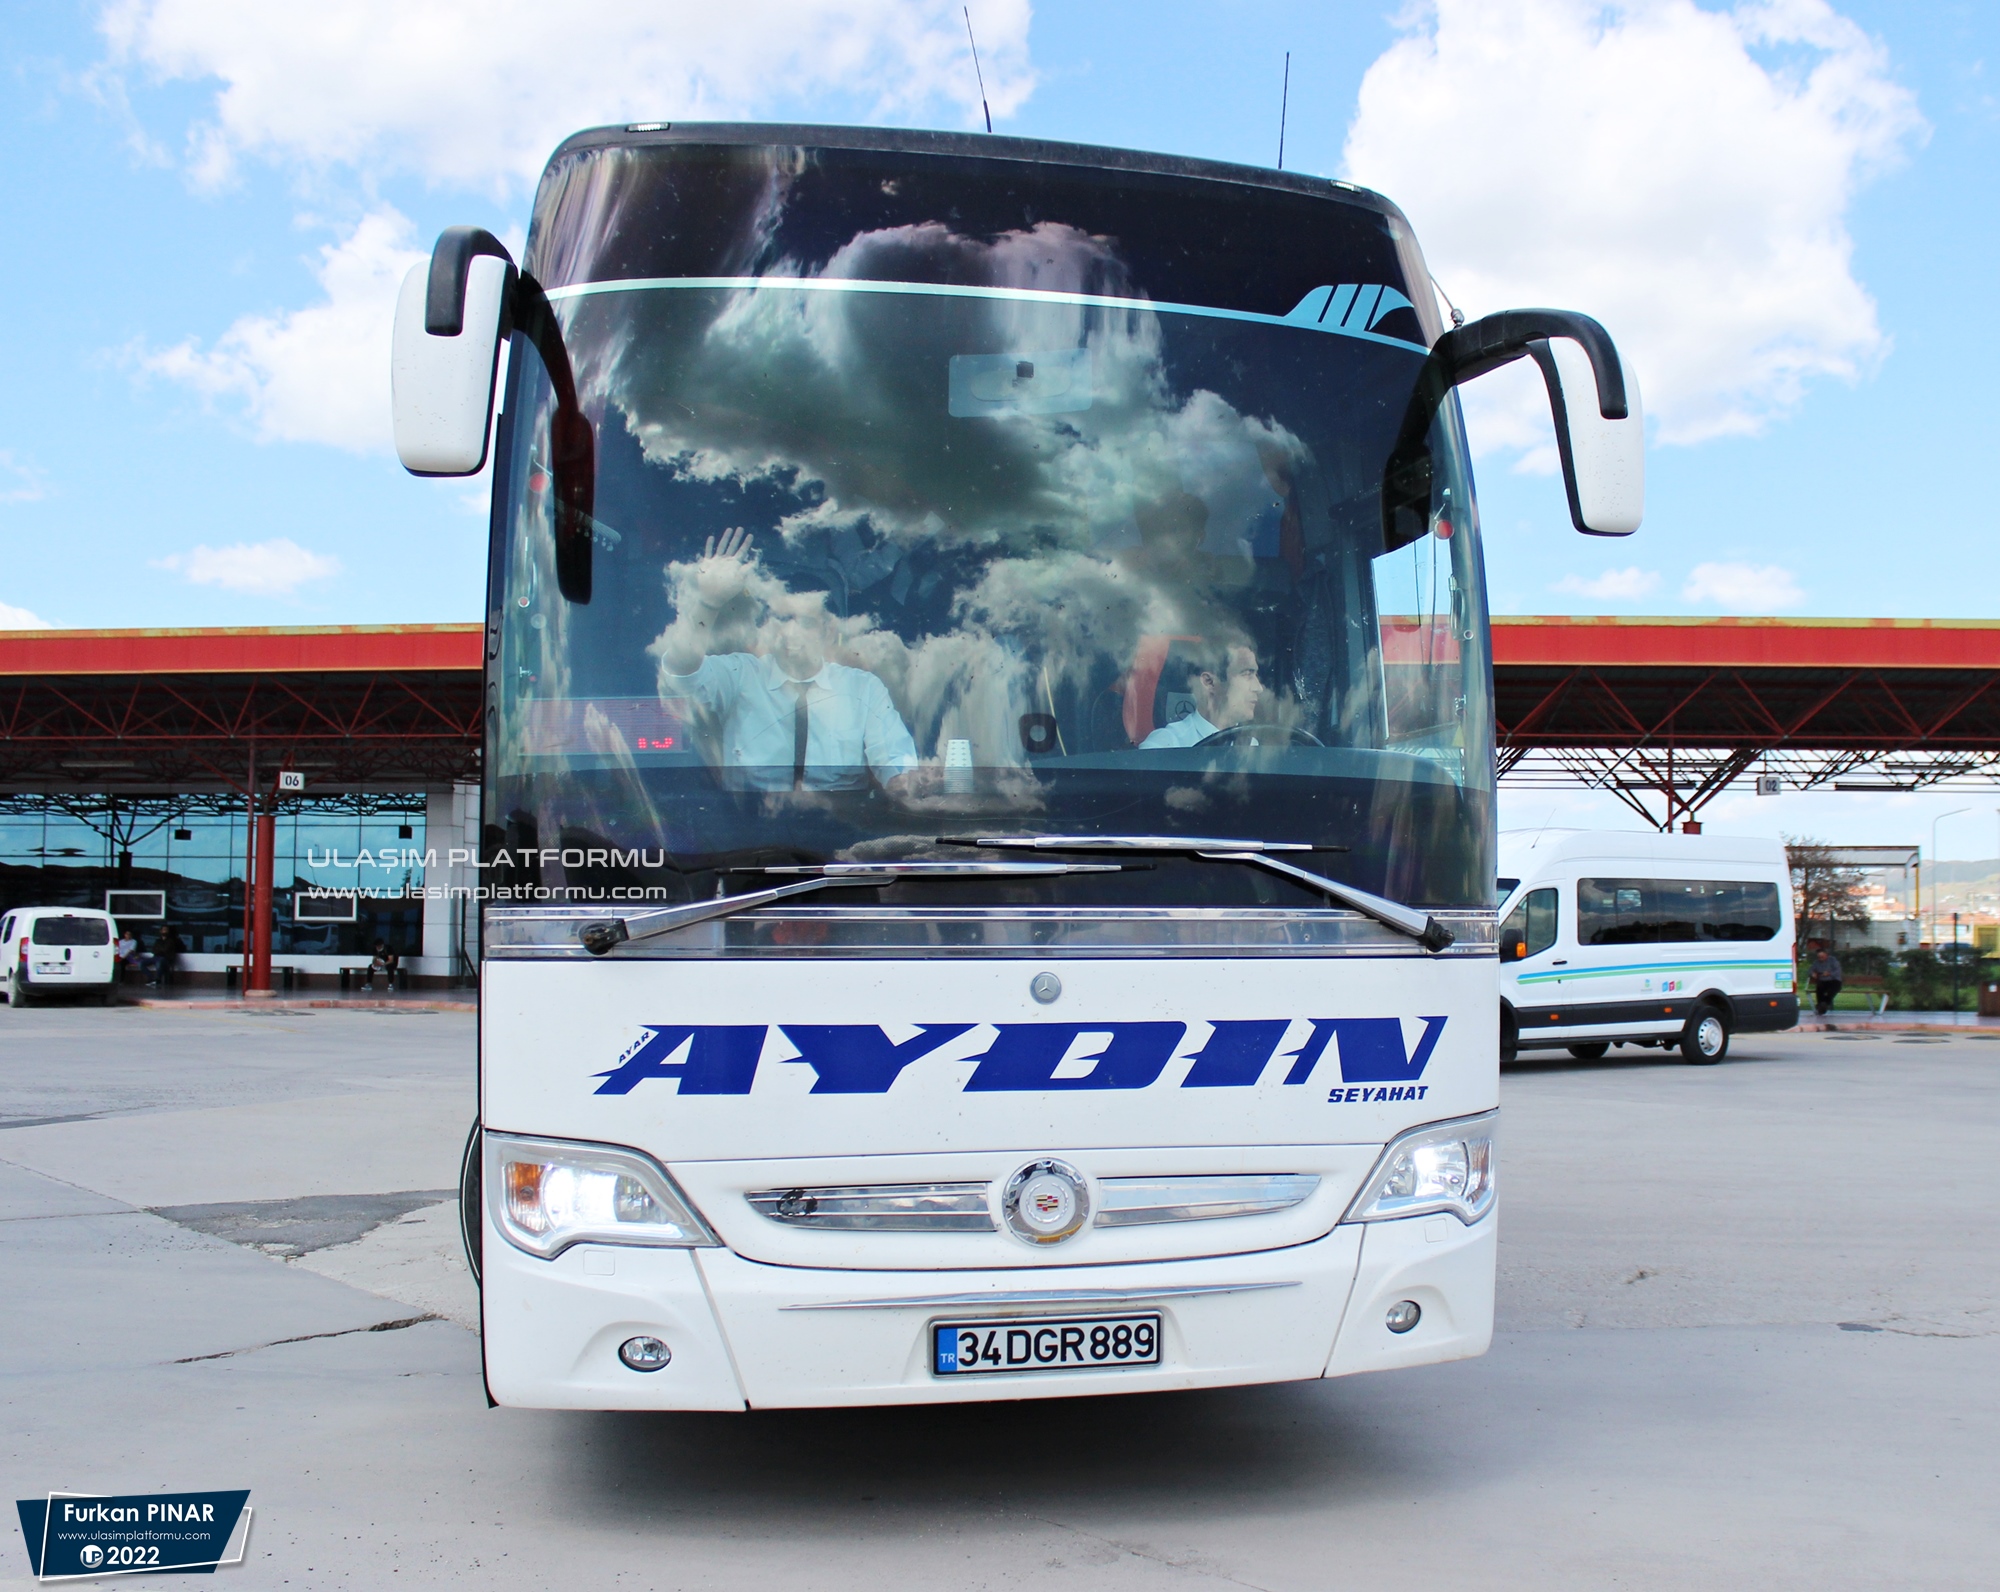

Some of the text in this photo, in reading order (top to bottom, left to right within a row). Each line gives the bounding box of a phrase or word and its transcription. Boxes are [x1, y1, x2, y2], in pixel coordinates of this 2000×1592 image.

[285, 775, 300, 787] 06
[1765, 780, 1777, 791] 02
[618, 1031, 650, 1065] AYAR
[592, 1016, 1449, 1095] AYDIN
[1327, 1086, 1429, 1103] SEYAHAT
[940, 1353, 956, 1364] TR
